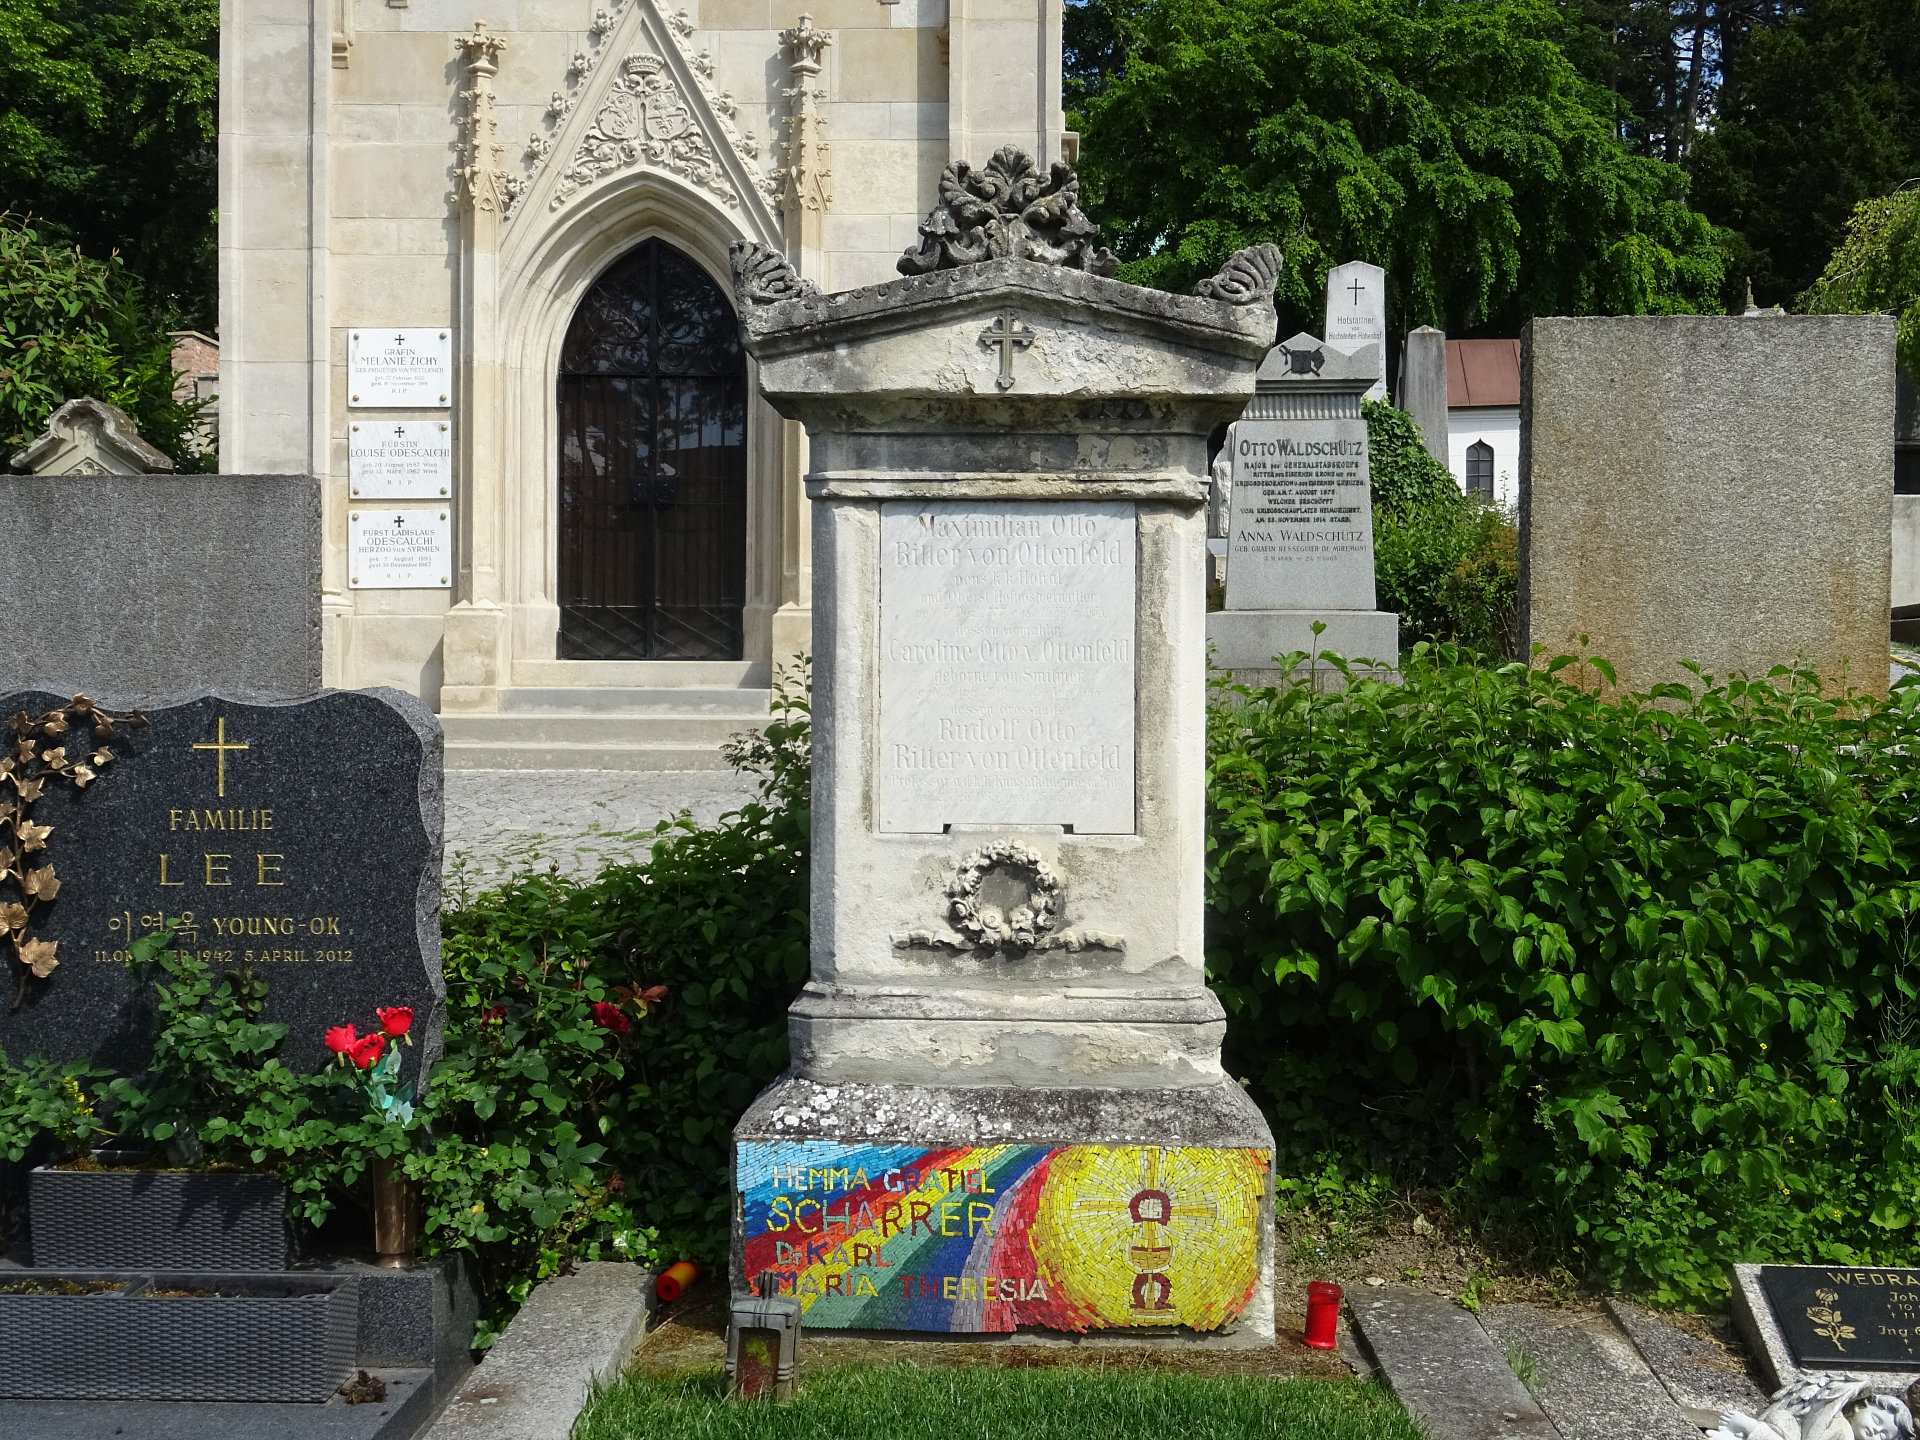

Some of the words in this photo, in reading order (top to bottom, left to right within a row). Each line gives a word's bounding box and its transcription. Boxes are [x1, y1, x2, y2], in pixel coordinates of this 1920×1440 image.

[360, 356, 406, 366] MELANIE
[410, 356, 439, 366] ZICHY
[350, 448, 386, 458] LOUISE
[389, 448, 450, 458] ODESCALCHI
[1243, 461, 1266, 470] MAJOR
[391, 529, 435, 537] LADISLAUS
[919, 514, 1042, 538] Maximilian
[1052, 513, 1097, 538] Otto
[366, 537, 433, 546] ODESCALCHI
[1237, 530, 1273, 542] ANNA
[407, 545, 440, 553] SYRMIEN
[895, 541, 962, 567] Ritter
[968, 548, 1011, 567] von
[1017, 539, 1123, 567] Ottenfeld
[889, 638, 972, 663] Caroline
[980, 638, 1018, 663] Otto
[1043, 638, 1130, 663] Ottenfeld
[934, 667, 991, 685] geborne
[939, 717, 1019, 743] Rudolf
[1029, 718, 1076, 743] Otto
[894, 743, 961, 770] Ritter
[967, 750, 1010, 770] von
[1017, 744, 1122, 770] Ottenfeld
[891, 774, 951, 790] Professor
[169, 809, 274, 831] FAMILIE
[159, 853, 285, 886] LEE
[212, 917, 342, 936] YOUNG-OK
[196, 949, 233, 963] 1942
[315, 949, 354, 963] 2012
[773, 1164, 872, 1192] HEMMA
[767, 1195, 997, 1239] SCHARRER
[806, 1241, 892, 1268] KARL
[775, 1271, 879, 1298] MARIA
[898, 1275, 1049, 1303] THERESIA
